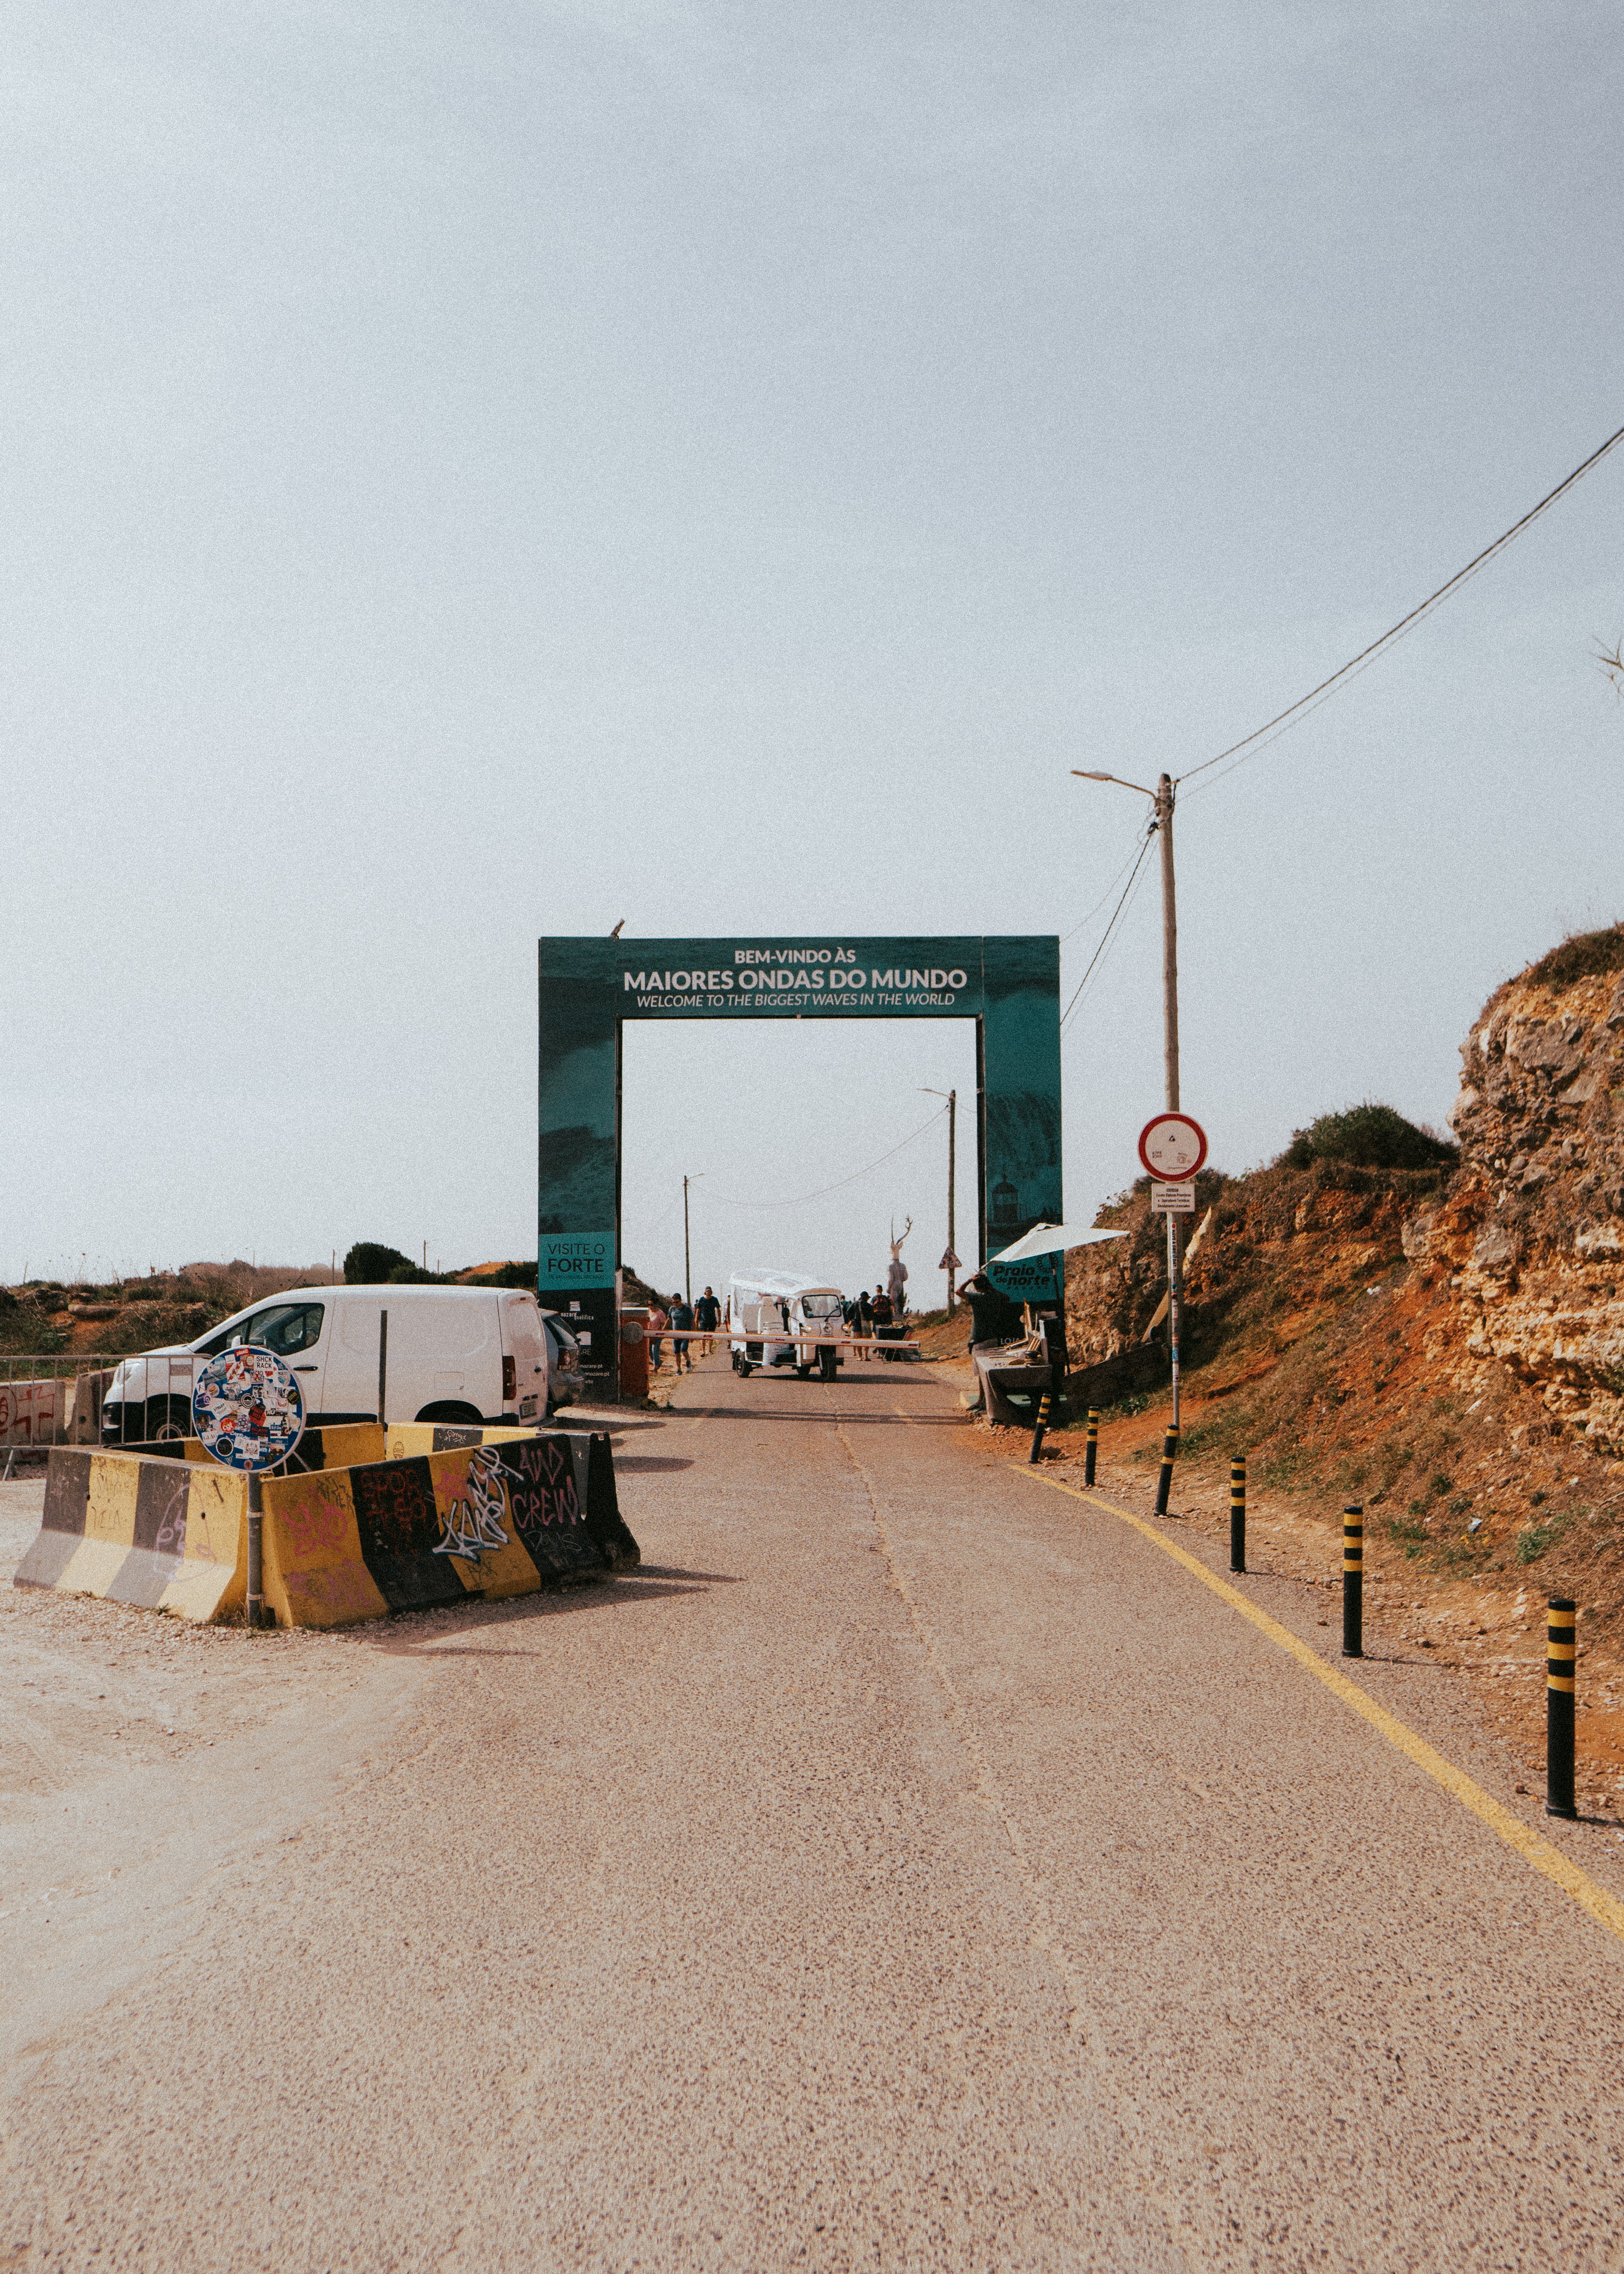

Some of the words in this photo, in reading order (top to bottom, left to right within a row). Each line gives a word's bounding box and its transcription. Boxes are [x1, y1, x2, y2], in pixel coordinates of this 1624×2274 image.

[735, 949, 832, 964] BEM-VINDO
[834, 946, 856, 963] ÀS
[624, 970, 734, 991] MAIORES
[738, 969, 825, 990] ONDAS
[830, 969, 867, 989] DO
[871, 969, 967, 989] MUNDO
[637, 994, 704, 1008] WELCOME
[706, 994, 724, 1006] TO
[727, 994, 753, 1006] THE
[754, 994, 810, 1006] BIGGEST
[812, 994, 857, 1006] WAVES
[860, 993, 875, 1005] IN
[877, 993, 903, 1005] THE
[906, 993, 955, 1005] WORLD
[547, 1243, 591, 1255] VISITE
[594, 1243, 605, 1255] O
[548, 1258, 604, 1273] FORTE
[1007, 1274, 1050, 1286] norte
[223, 1422, 233, 1431] cgt
[512, 1475, 579, 1528] CREW
